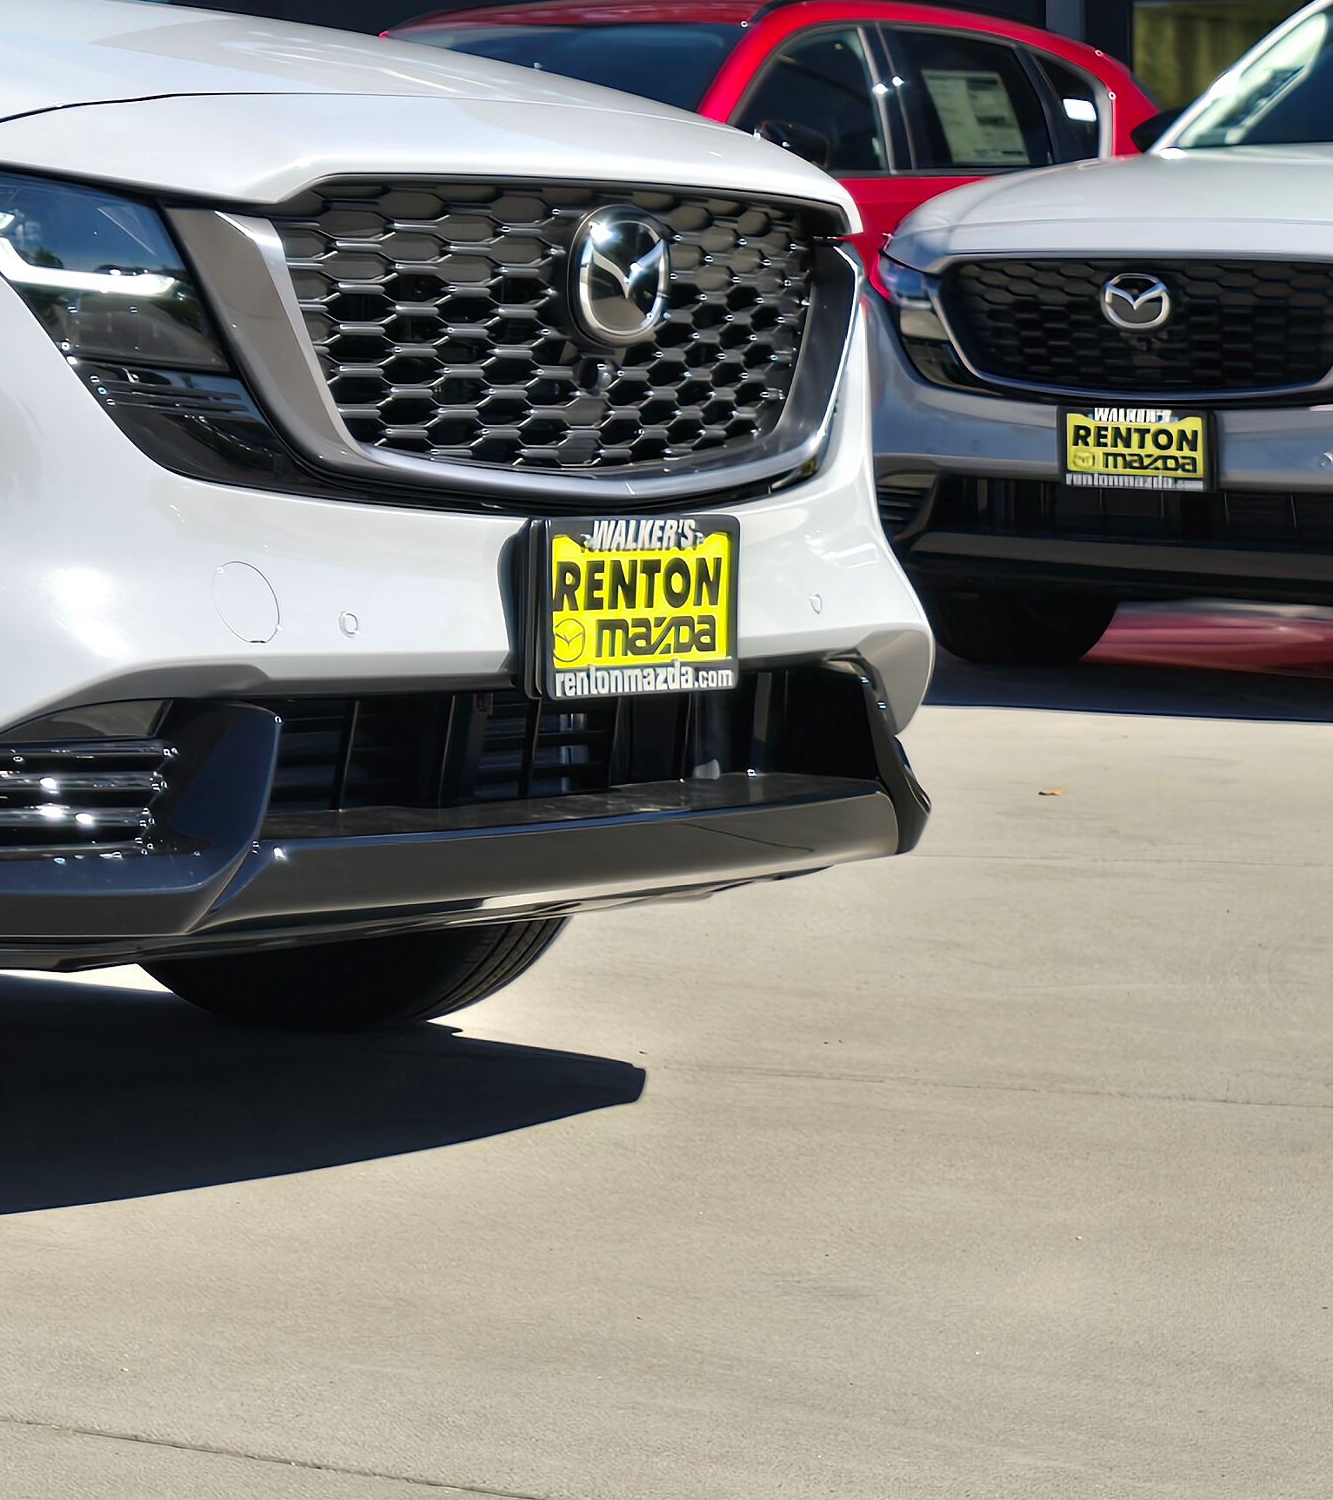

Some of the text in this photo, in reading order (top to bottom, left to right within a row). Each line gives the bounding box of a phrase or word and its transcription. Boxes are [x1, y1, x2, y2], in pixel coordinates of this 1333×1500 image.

[1072, 425, 1199, 452] RENTON
[591, 518, 697, 552] WALKER'S
[552, 556, 723, 612] RENTON
[555, 659, 733, 698] rentonmazda.com
